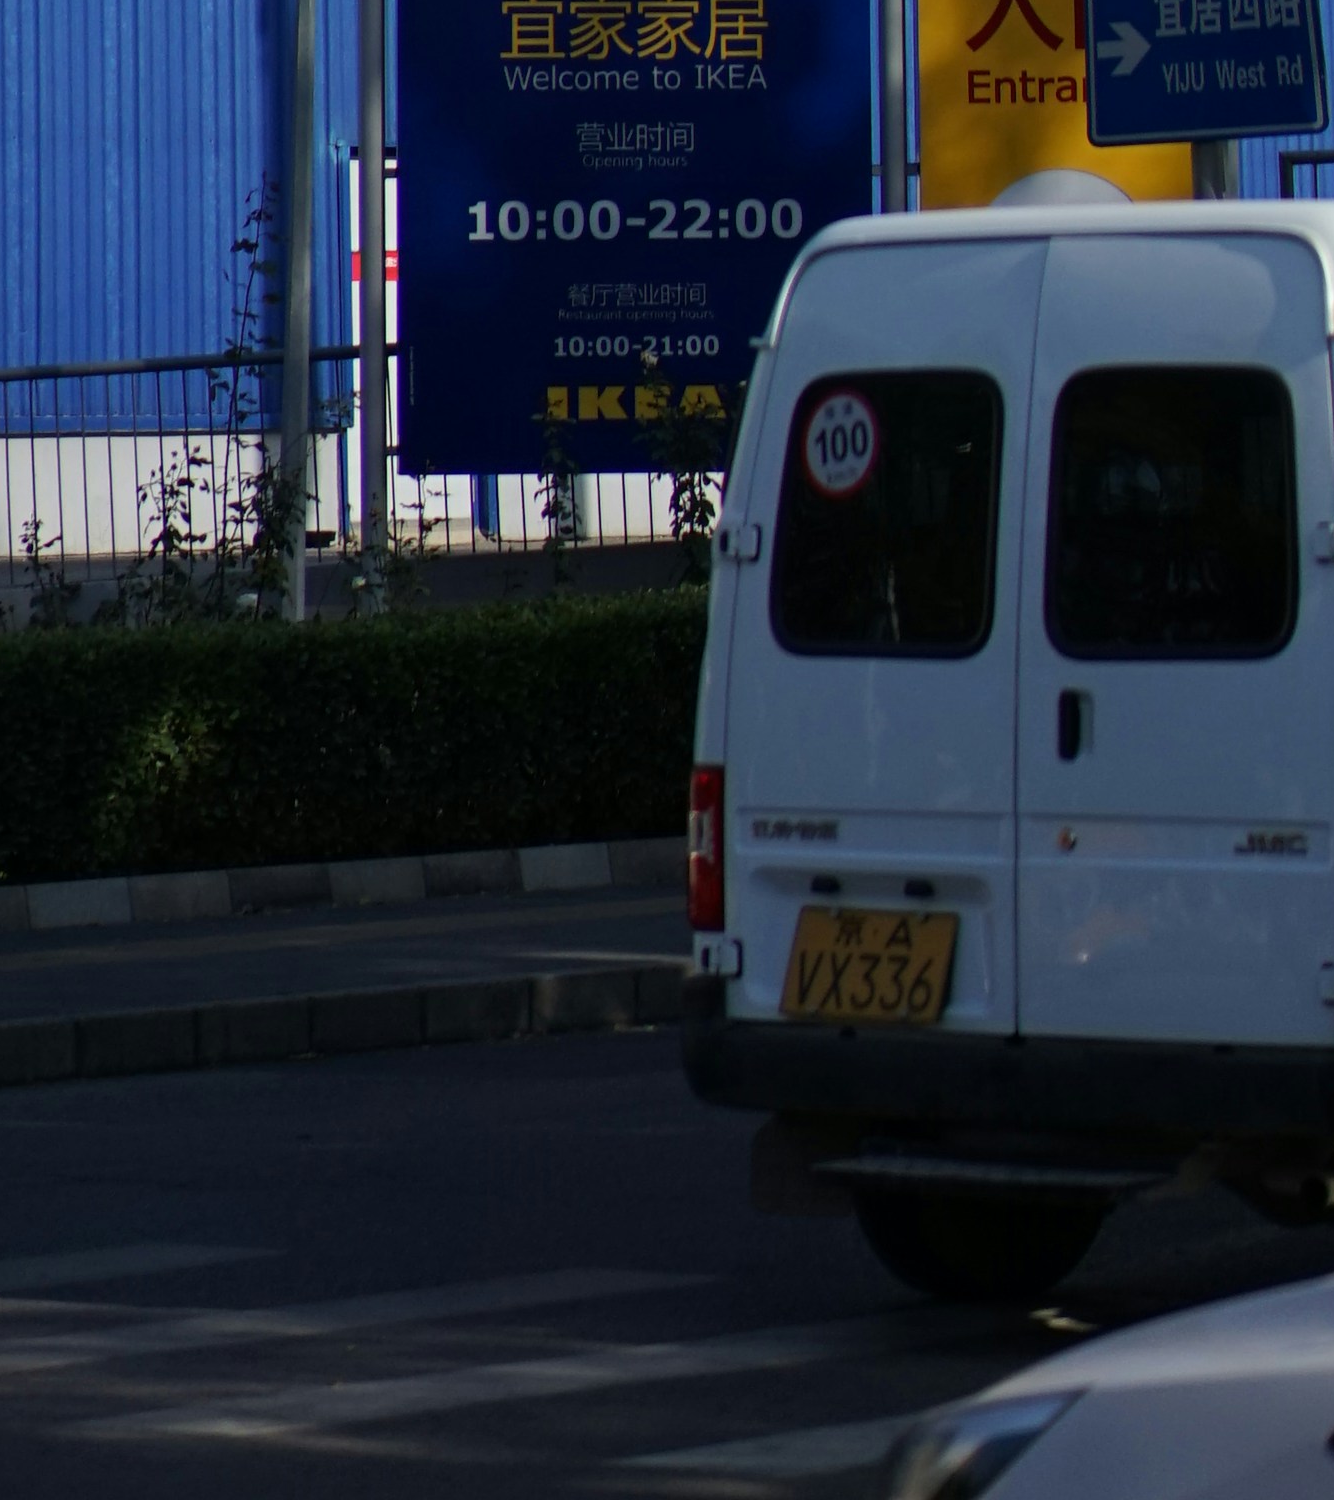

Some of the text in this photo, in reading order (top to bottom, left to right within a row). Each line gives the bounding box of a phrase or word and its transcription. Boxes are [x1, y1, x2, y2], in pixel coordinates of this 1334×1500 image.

[503, 64, 768, 91] Welcome to IKEA
[968, 69, 1087, 104] Entra
[1162, 53, 1304, 94] YIJU West Rd
[576, 121, 695, 152] 营业时间
[582, 153, 688, 171] Opening hours
[468, 198, 803, 242] 10:00-22:00
[568, 282, 707, 307] 餐厅营业时间
[558, 308, 715, 322] Restaurant opening hours
[554, 334, 721, 358] 10:00-21:00
[546, 384, 728, 421] IKEA
[814, 419, 869, 467] 100
[798, 951, 934, 1013] VX336
